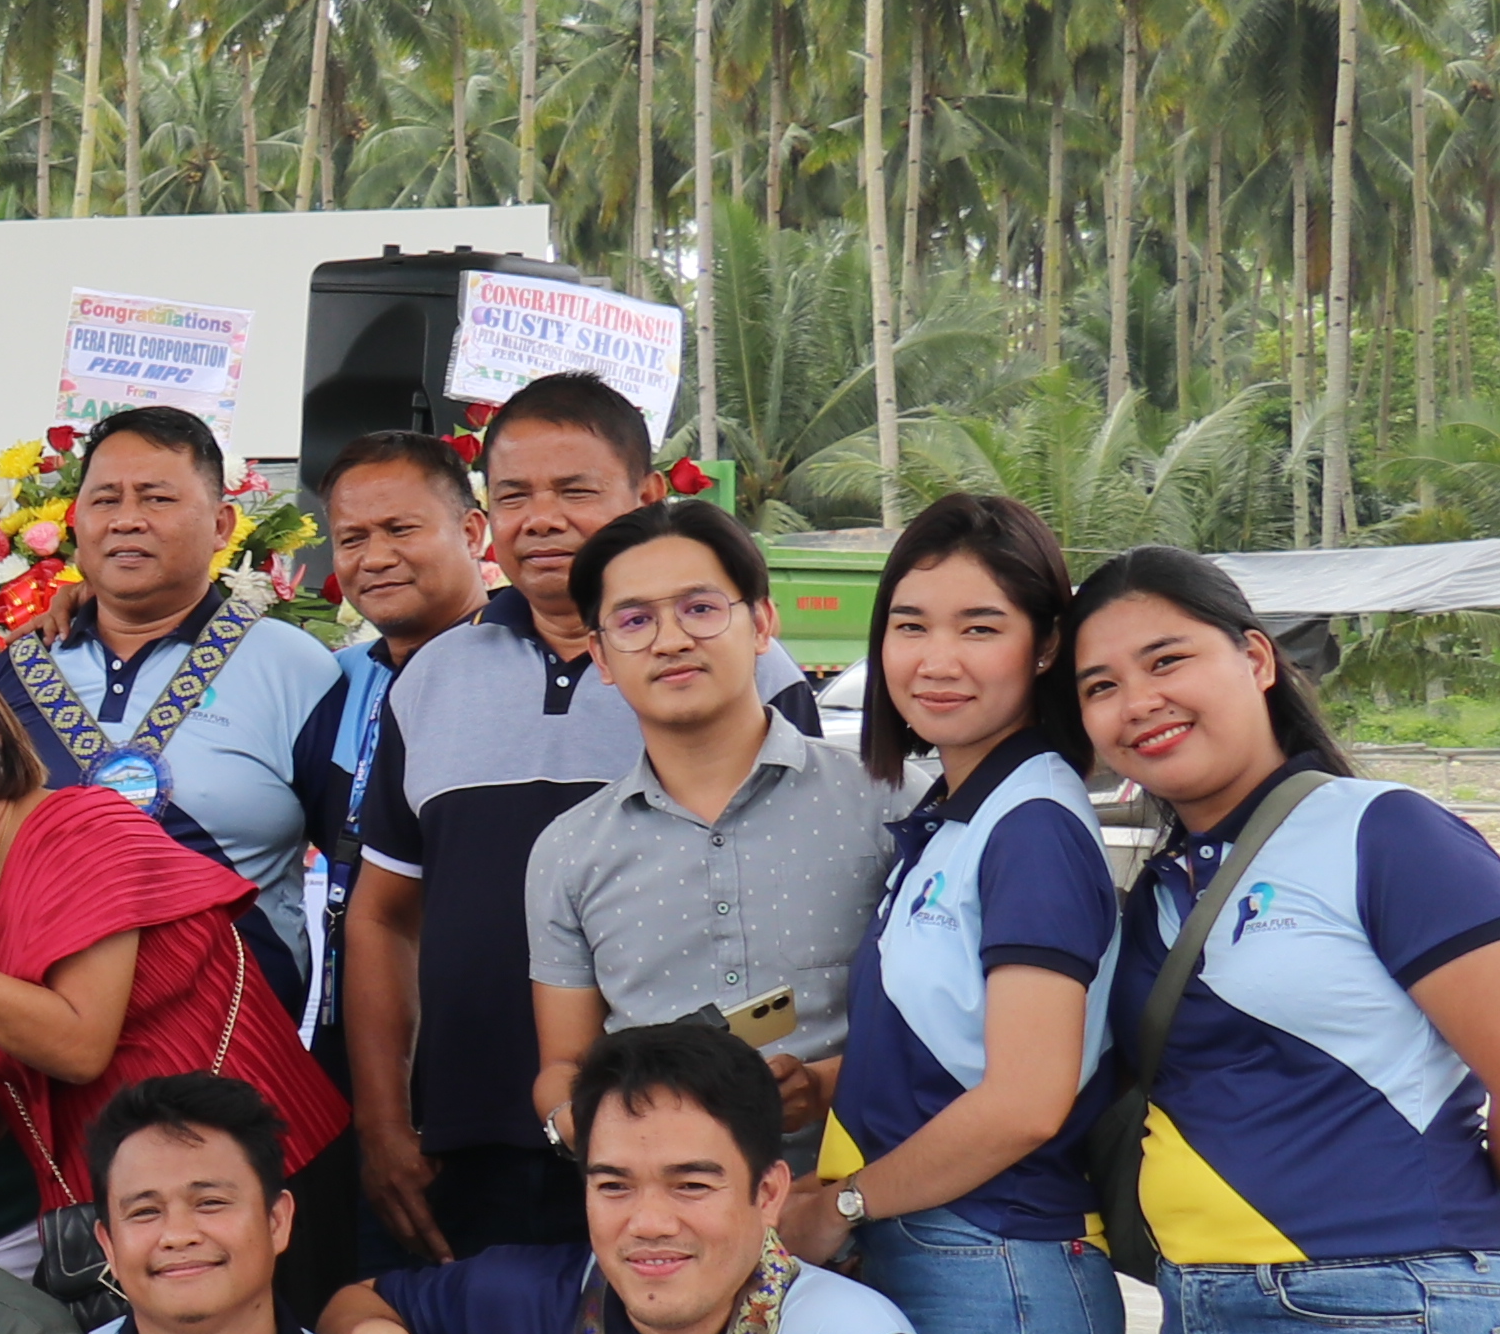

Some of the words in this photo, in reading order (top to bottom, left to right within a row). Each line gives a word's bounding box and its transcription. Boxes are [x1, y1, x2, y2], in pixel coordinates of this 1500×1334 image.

[79, 298, 233, 333] Congratulations
[480, 283, 675, 346] CONGRATULATIONS!!!
[73, 328, 106, 354] PERA
[108, 332, 137, 358] FUEL
[138, 336, 229, 369] CORPORATION
[483, 306, 572, 345] GUSTY
[575, 326, 666, 372] SHONE
[86, 356, 142, 378] PERA
[142, 364, 194, 384] MPC
[125, 385, 157, 399] From
